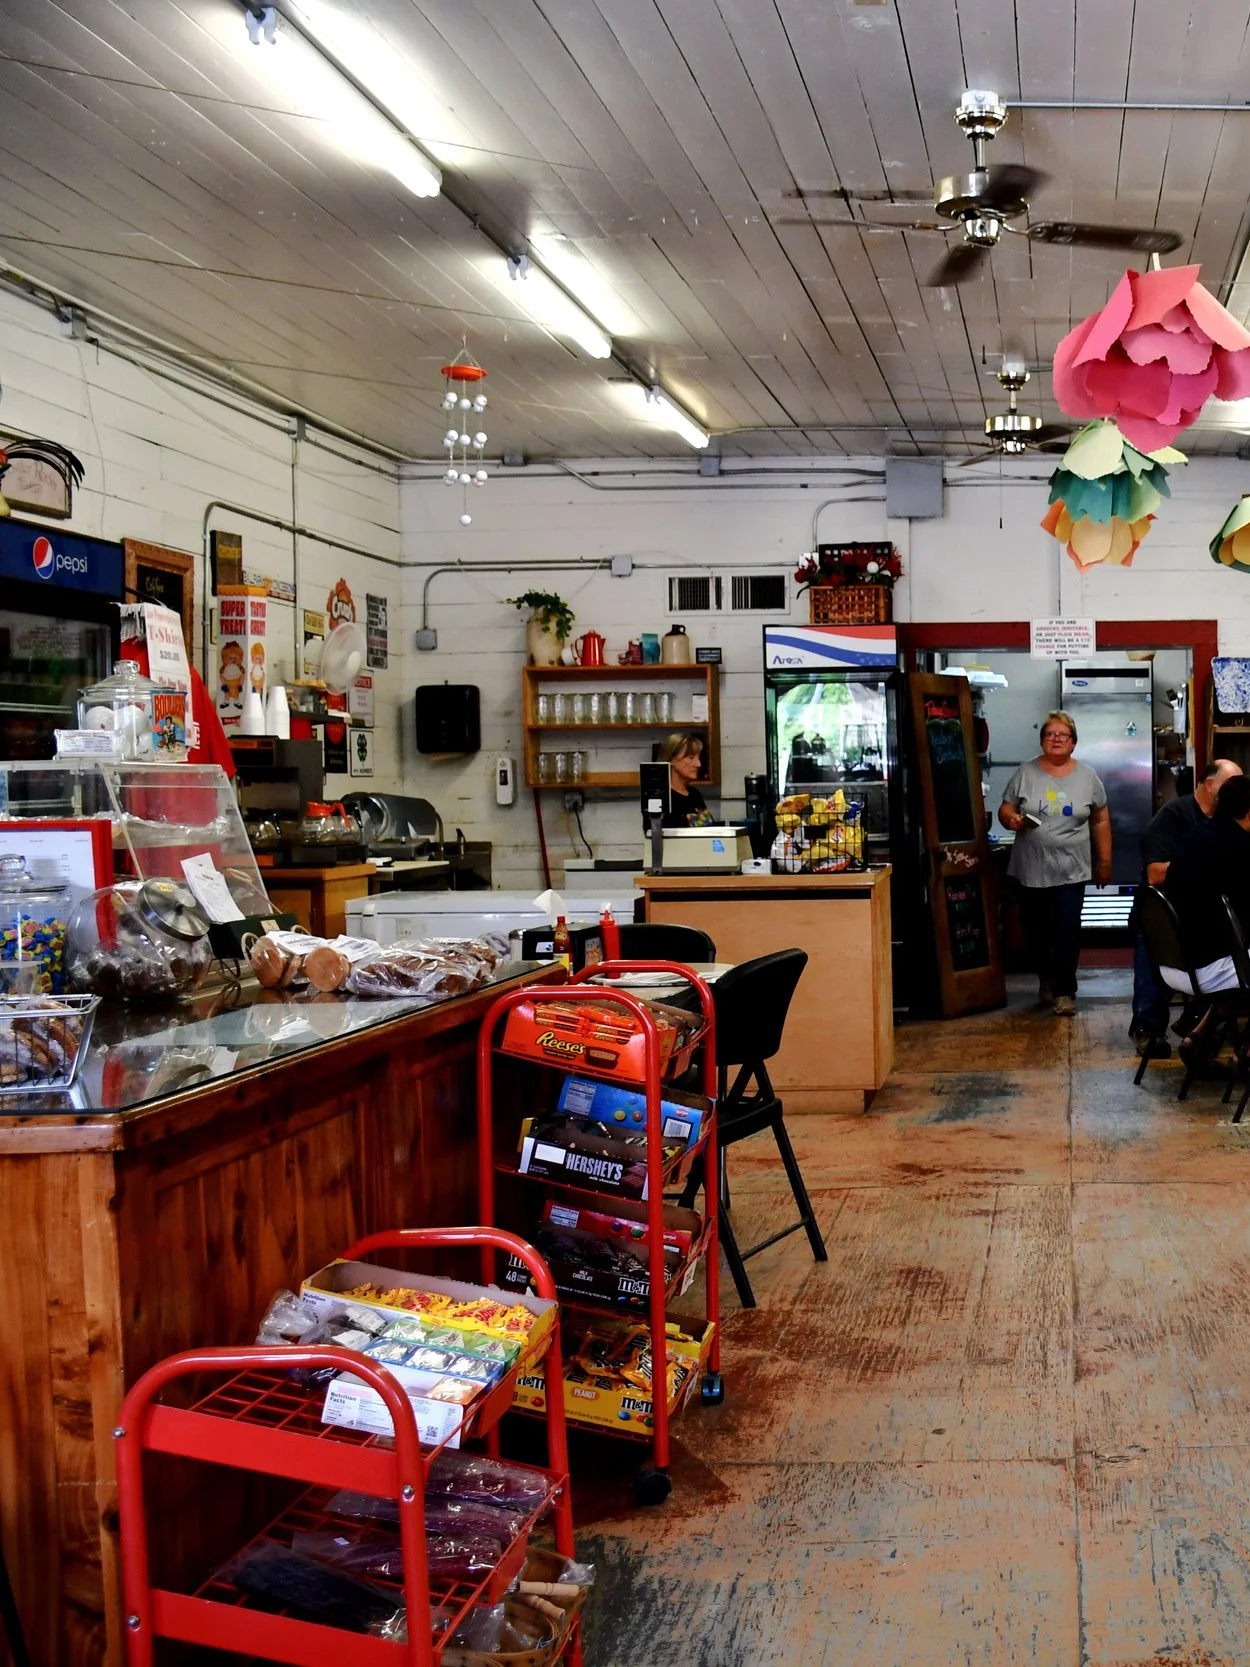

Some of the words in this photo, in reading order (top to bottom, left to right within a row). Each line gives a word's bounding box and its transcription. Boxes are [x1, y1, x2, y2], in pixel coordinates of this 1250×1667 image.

[56, 554, 88, 575] pepsi
[220, 600, 246, 617] SUPER
[1039, 799, 1073, 817] kind
[536, 1031, 586, 1055] Reese's
[566, 1152, 624, 1181] HERSHEY'S
[506, 1270, 517, 1282] 48
[573, 1272, 593, 1282] CHOCOLATE
[618, 1277, 650, 1296] m&m
[303, 1291, 326, 1303] Nutrition
[329, 1396, 346, 1405] Facts
[330, 1391, 357, 1402] Nutrition
[574, 1387, 597, 1400] PEANUT
[621, 1396, 652, 1413] m&m
